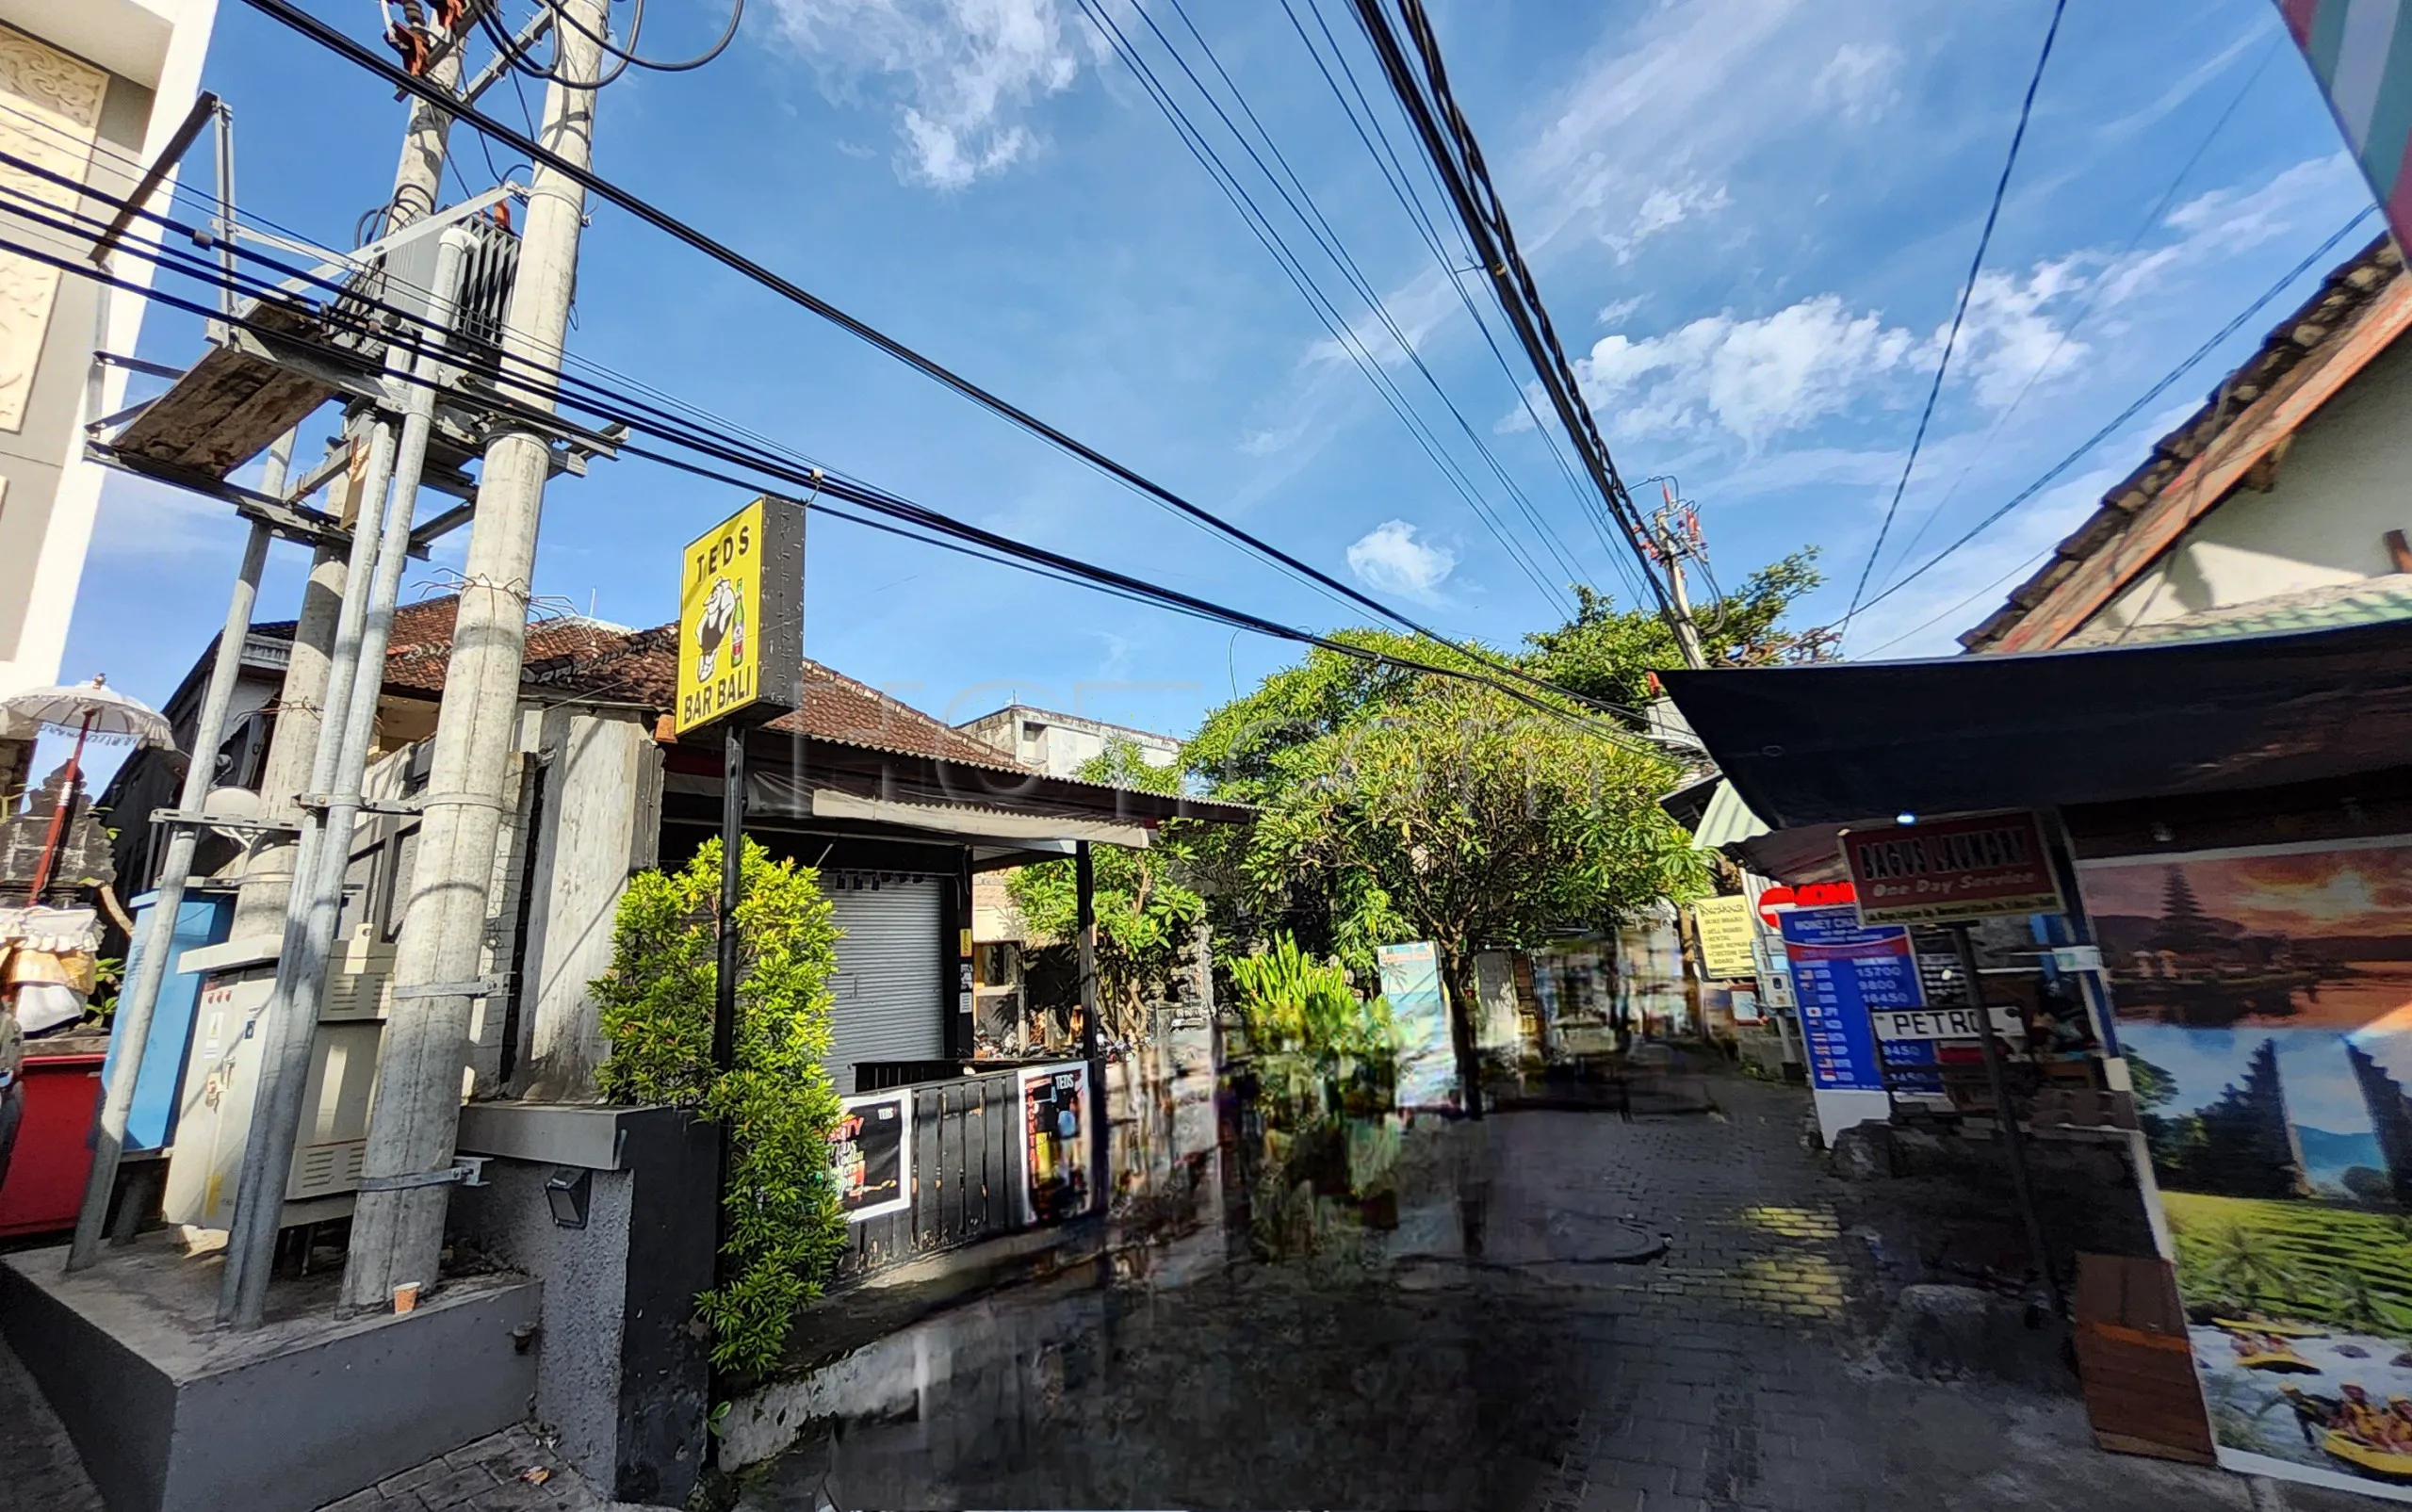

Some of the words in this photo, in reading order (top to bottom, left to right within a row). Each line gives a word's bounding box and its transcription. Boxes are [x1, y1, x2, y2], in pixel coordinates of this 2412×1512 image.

[696, 525, 750, 583] TEDS
[683, 685, 713, 726] BAR
[717, 665, 752, 709] BALI
[1858, 837, 1928, 881] BAGUS
[1928, 825, 2032, 874] LAUNDRY
[1873, 883, 1910, 897] One
[1916, 879, 1953, 894] Day
[1959, 870, 2036, 889] Service
[1855, 967, 1902, 977] 15700
[1055, 1074, 1074, 1090] TEDS
